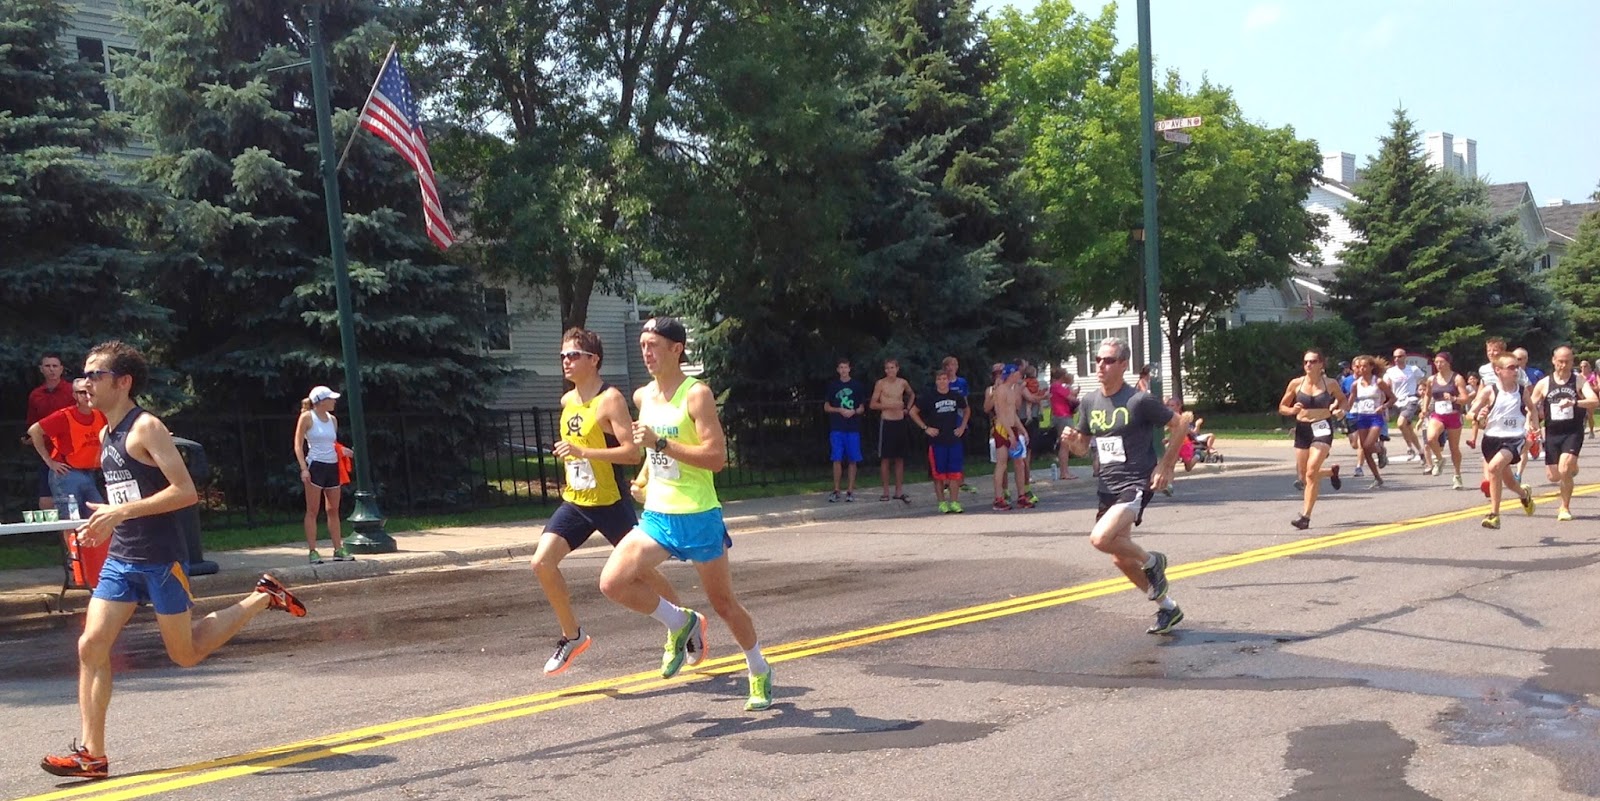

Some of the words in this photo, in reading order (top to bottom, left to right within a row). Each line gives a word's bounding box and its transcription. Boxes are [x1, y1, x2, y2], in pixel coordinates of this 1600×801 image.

[1171, 119, 1183, 128] AVE
[1101, 442, 1115, 452] 437
[650, 453, 668, 465] 555
[573, 466, 580, 477] 7
[112, 489, 129, 505] 131
